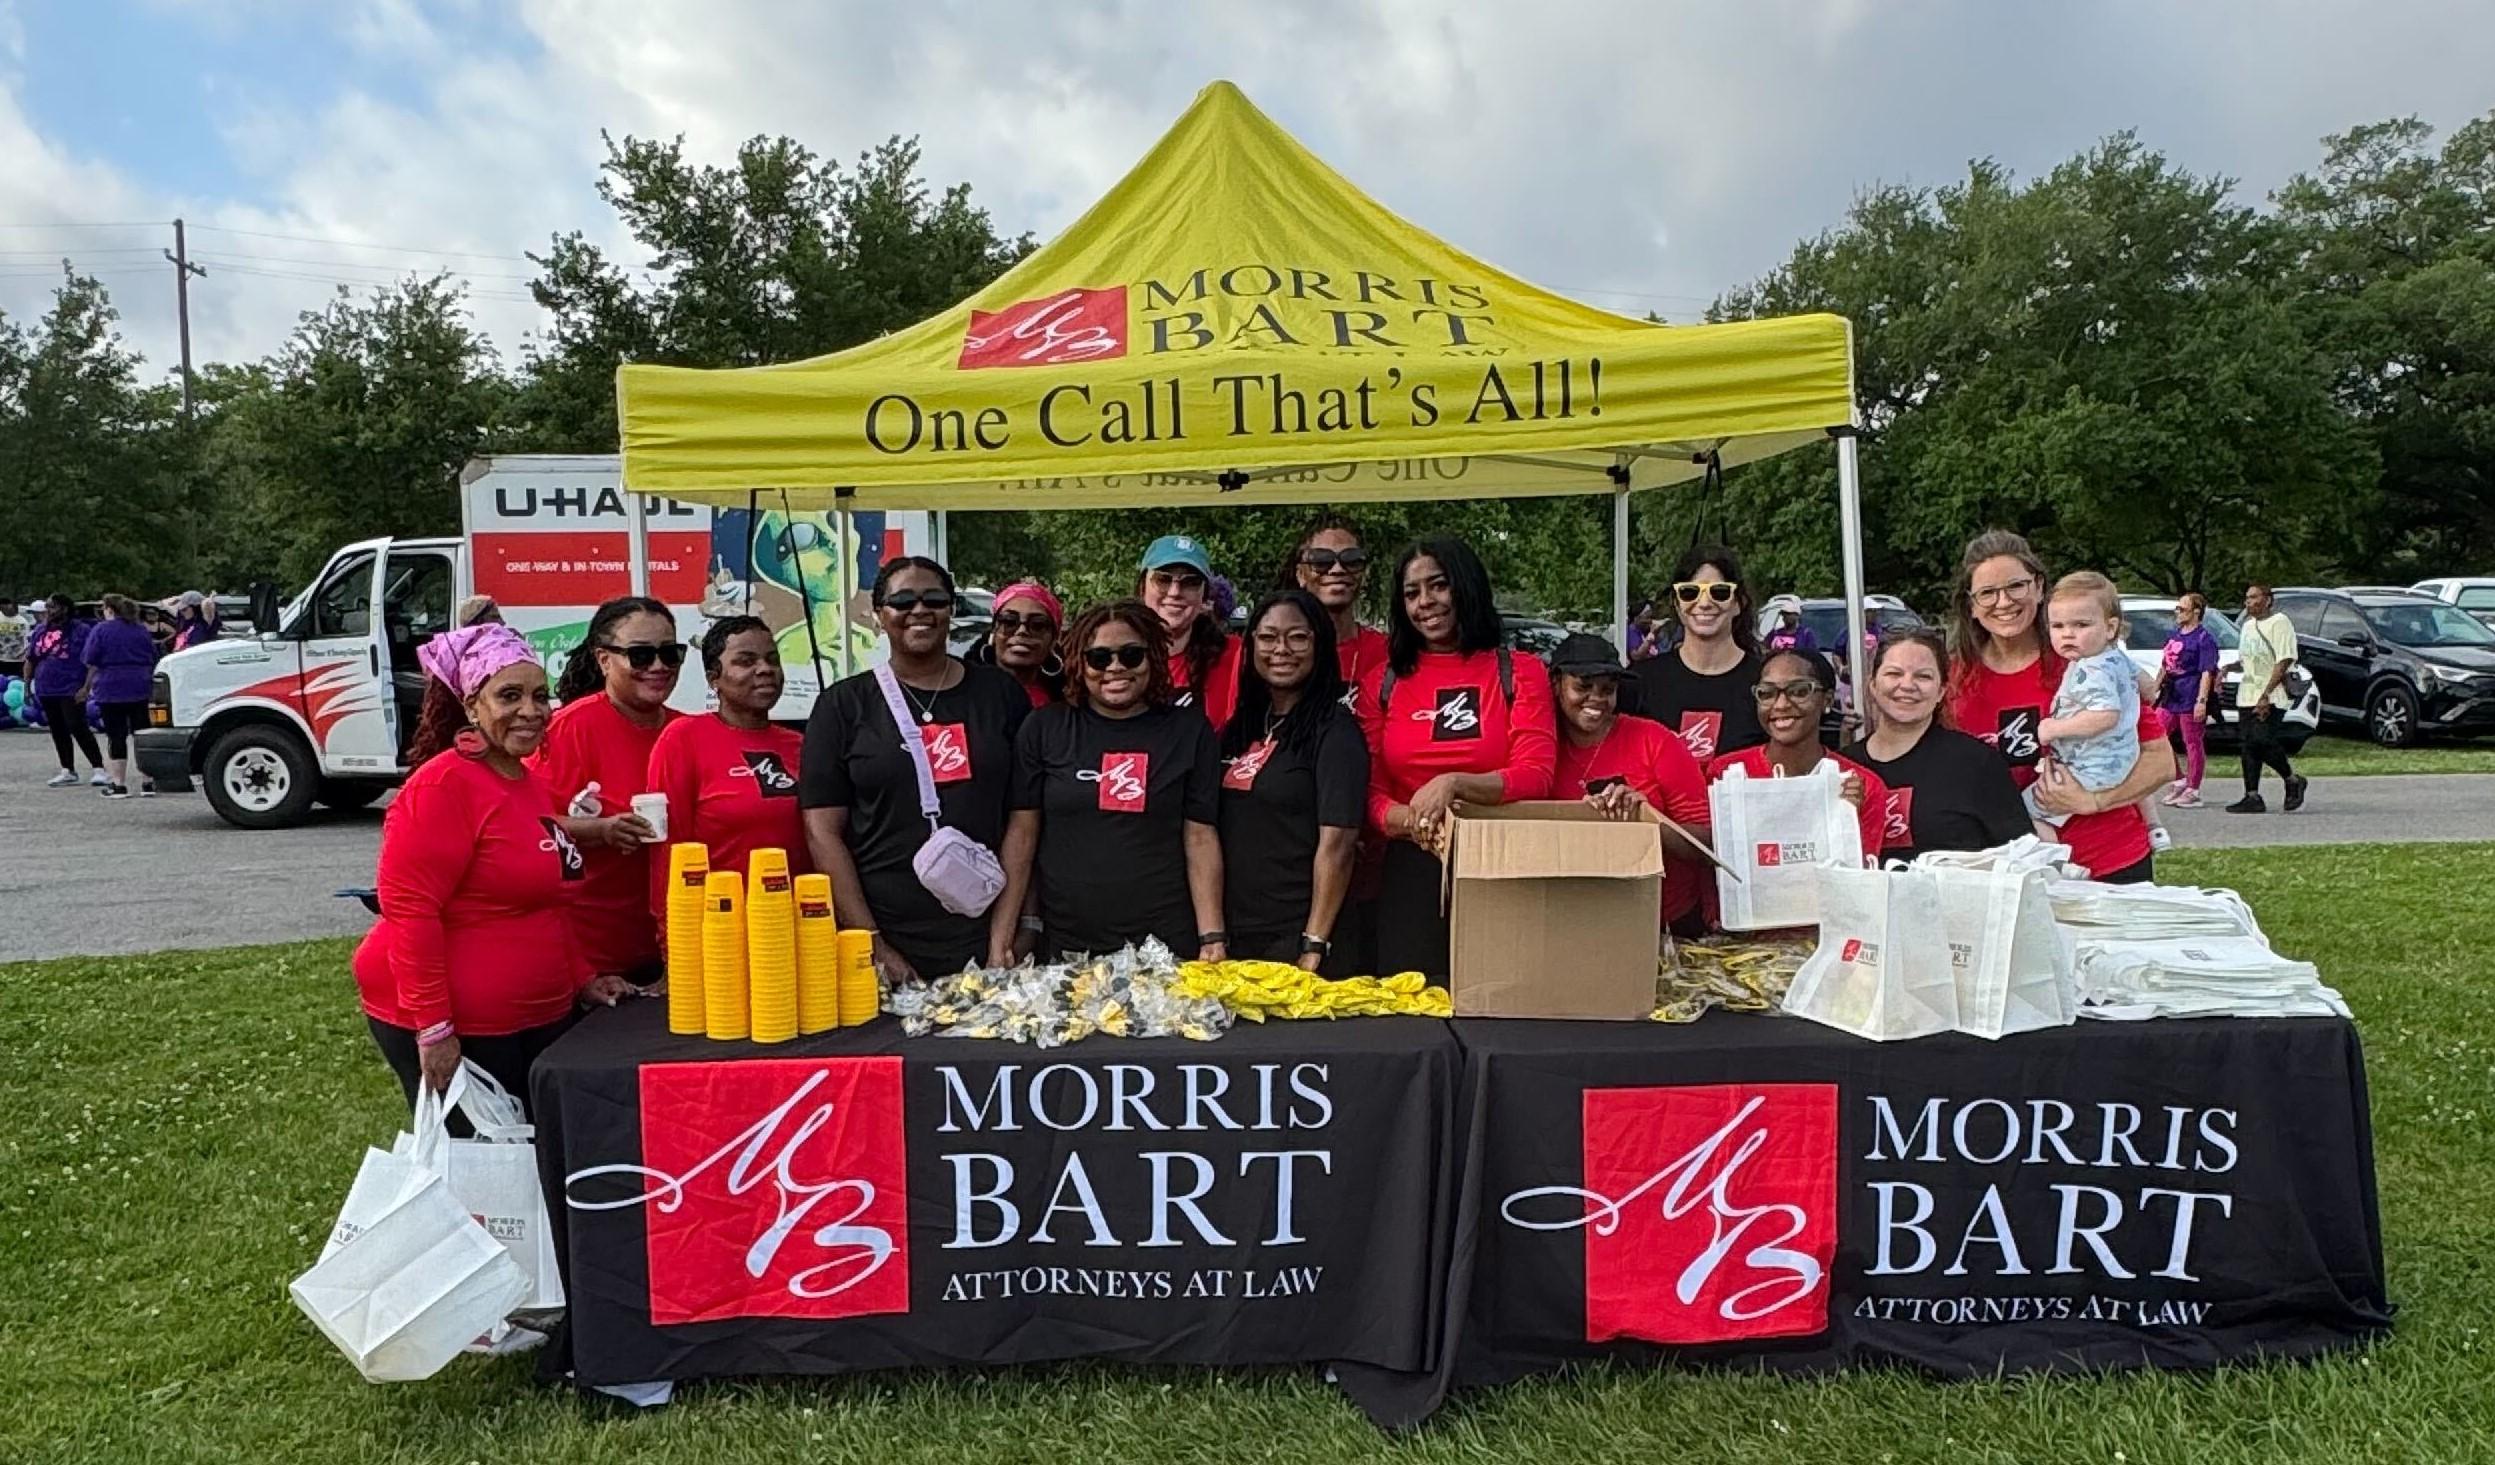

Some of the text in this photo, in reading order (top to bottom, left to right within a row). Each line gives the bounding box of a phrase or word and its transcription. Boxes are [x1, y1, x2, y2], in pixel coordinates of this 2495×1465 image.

[1140, 265, 1490, 312] MORRIS
[1143, 303, 1496, 356] BART
[864, 356, 1602, 455] One Call That's All!
[936, 1063, 1333, 1132] MORRIS
[1865, 1096, 2239, 1173] MORRIS
[941, 1151, 1332, 1249] BART
[1865, 1182, 2232, 1282] BART
[942, 1266, 1323, 1302] ATTORNEYS AT LAW
[1854, 1294, 2213, 1327] ATTORNEYS AT LAW
